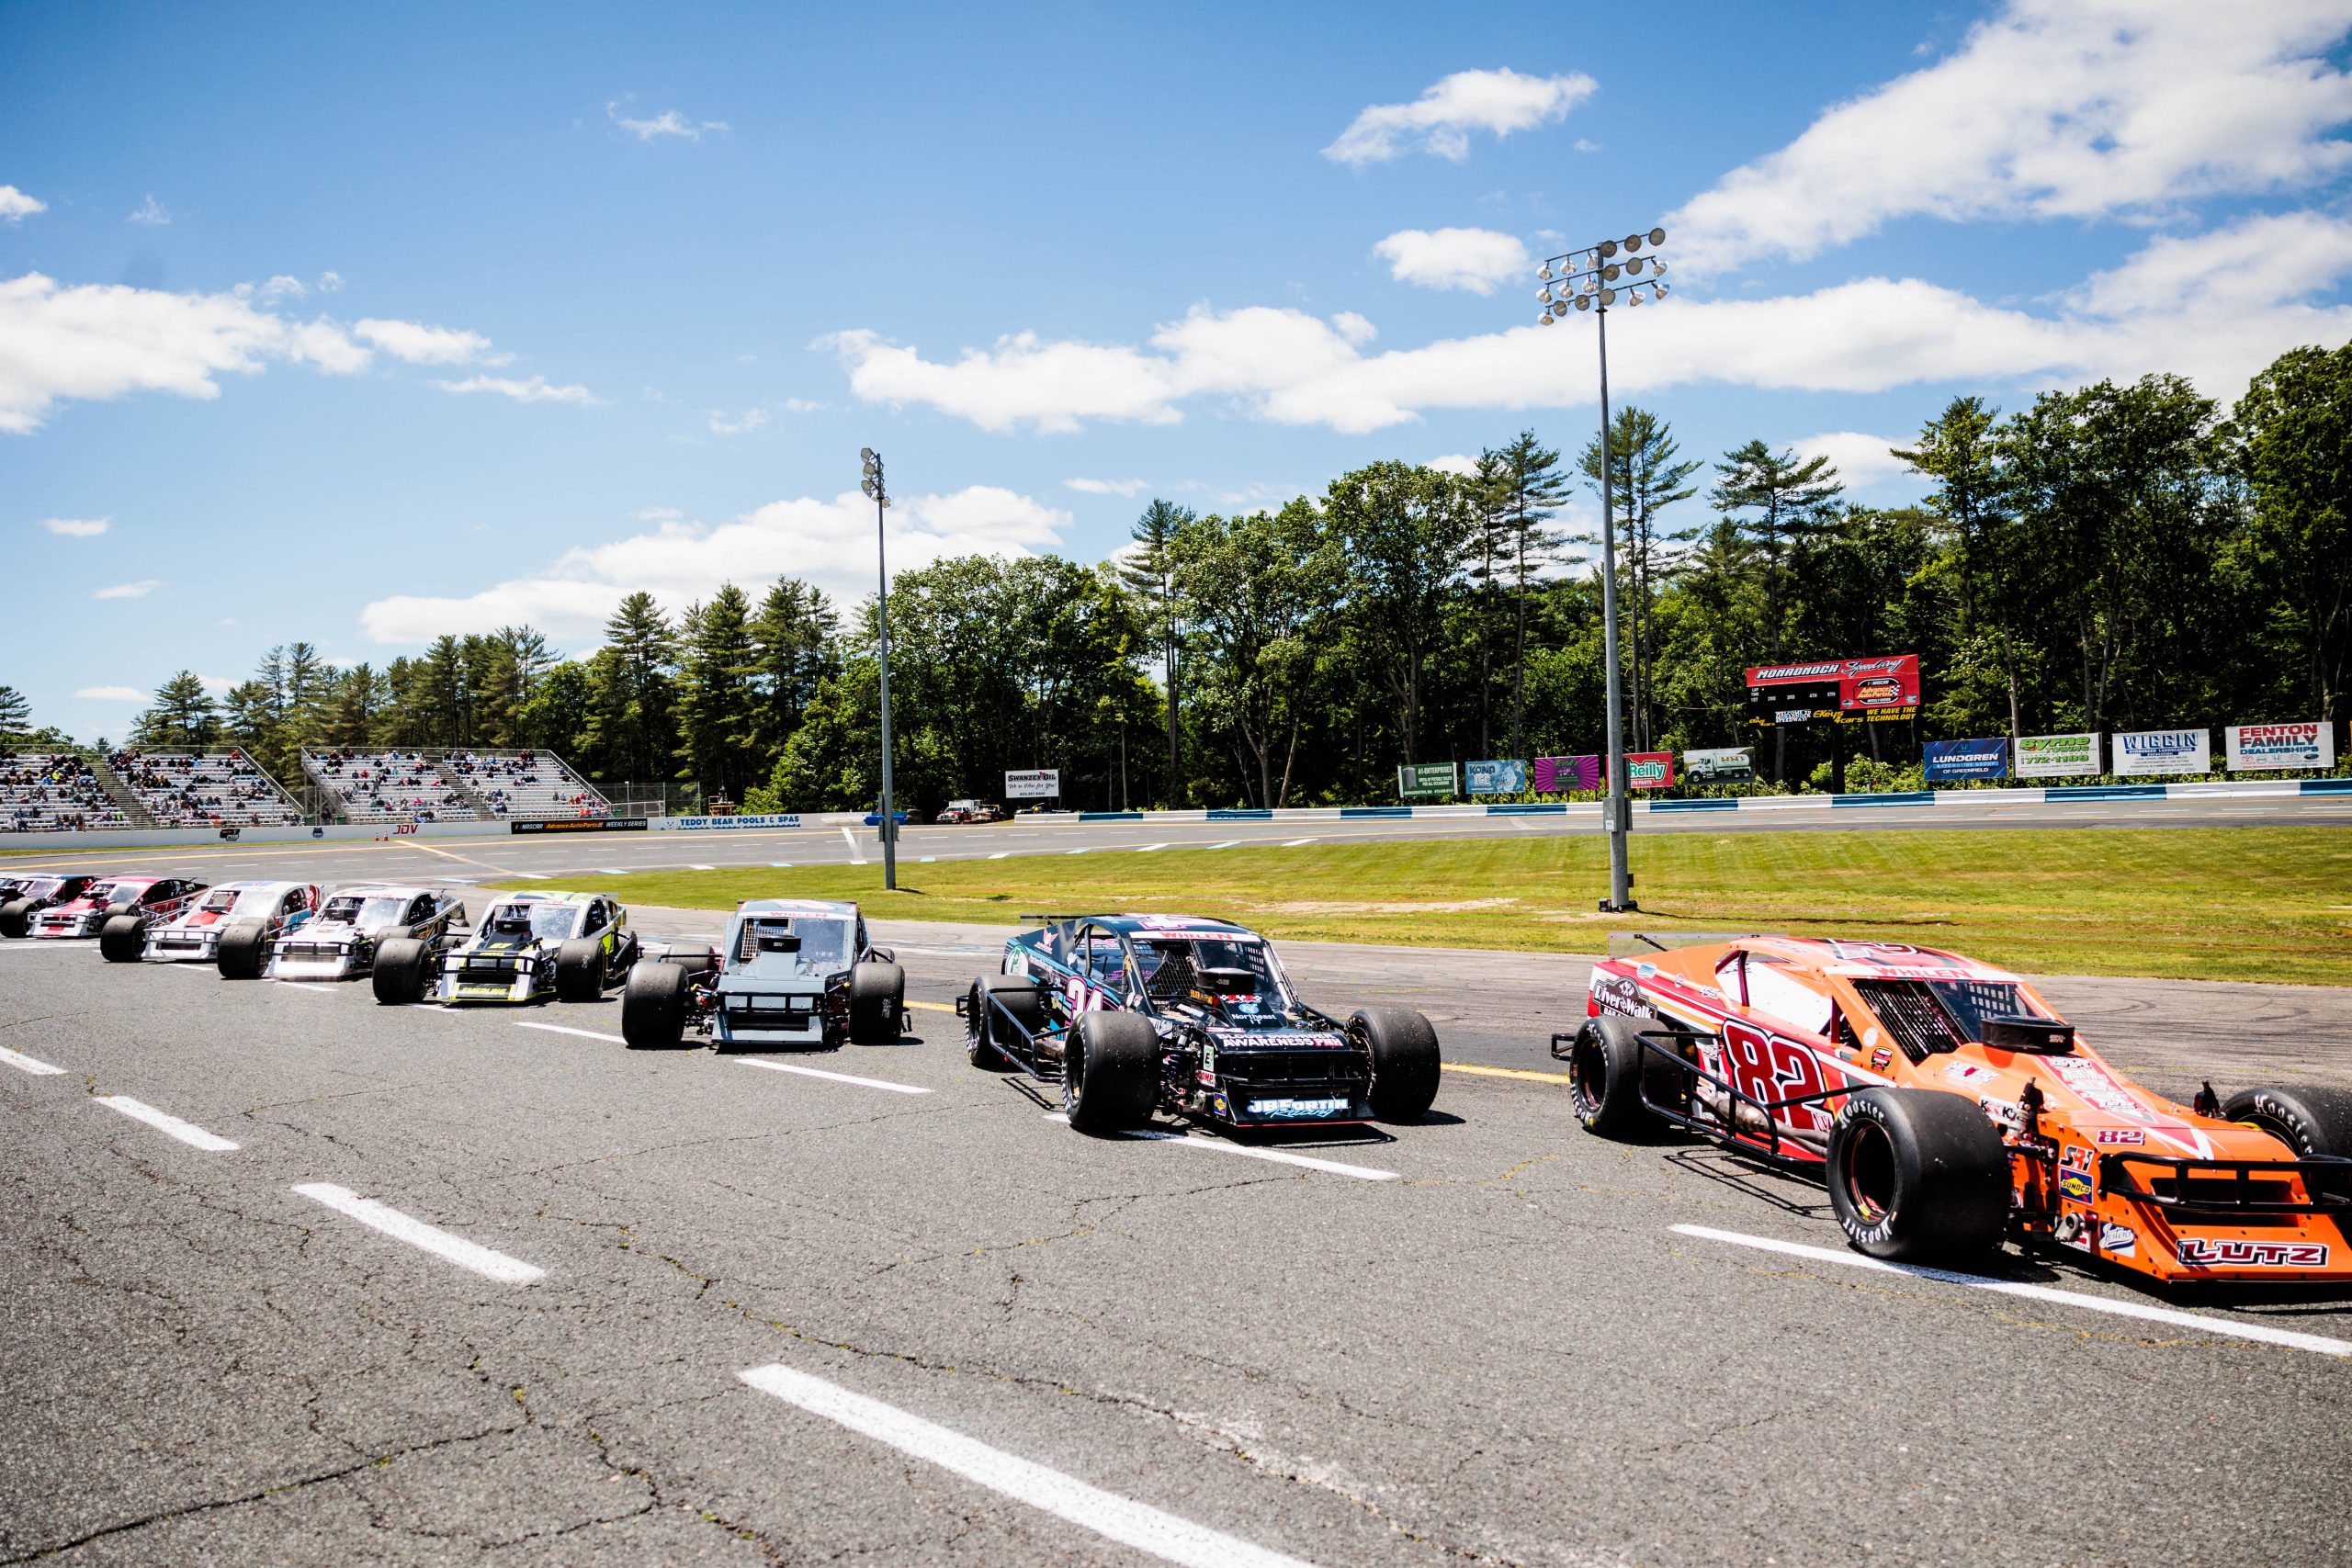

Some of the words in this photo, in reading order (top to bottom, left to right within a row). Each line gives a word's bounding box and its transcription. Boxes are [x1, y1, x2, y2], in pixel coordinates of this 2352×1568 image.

[1756, 663, 1841, 680] MONADNOCK
[1880, 706, 1900, 715] HAVE
[1866, 713, 1917, 722] TECHNOLOGY
[2239, 724, 2318, 738] FENTON
[2019, 737, 2091, 750] Byrne
[2123, 732, 2198, 749] WIGGIN
[2239, 734, 2319, 749] FAMILY
[2240, 746, 2319, 755] DEALERSHIPS
[1932, 753, 1999, 763] LUNDGREN
[1468, 764, 1495, 775] KONA
[1630, 762, 1665, 779] Reilly
[1008, 773, 1042, 782] SWANZEY
[1474, 774, 1490, 786] ICE
[1159, 931, 1233, 941] WHELEN
[1872, 967, 1973, 978] WHELEN
[461, 987, 507, 995] EMERLING
[1595, 985, 1622, 1009] River
[1626, 999, 1653, 1019] Walk
[1222, 1039, 1314, 1047] AWARENESS
[1723, 1018, 1835, 1132] 82
[1838, 1100, 1884, 1130] Hoosier
[2098, 1130, 2144, 1145] 82
[2061, 1179, 2092, 1194] SUNOCO
[2177, 1239, 2329, 1267] LUTZ
